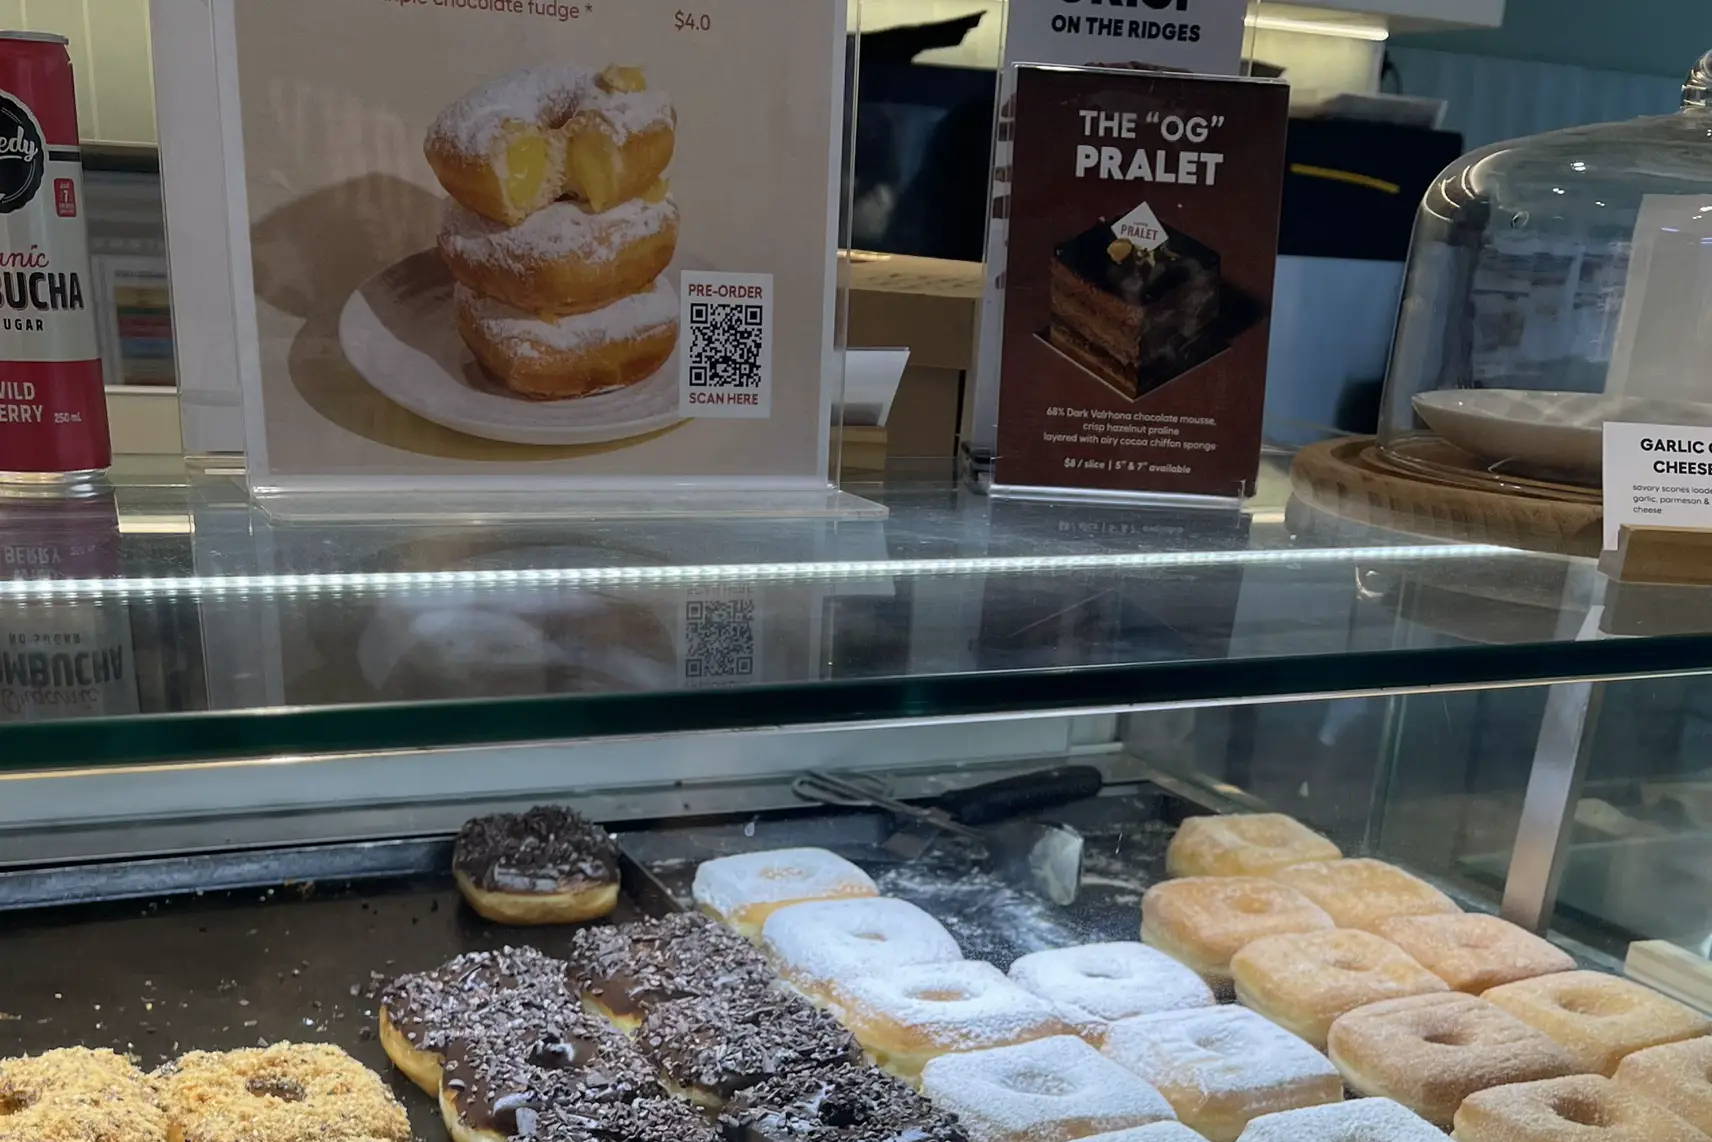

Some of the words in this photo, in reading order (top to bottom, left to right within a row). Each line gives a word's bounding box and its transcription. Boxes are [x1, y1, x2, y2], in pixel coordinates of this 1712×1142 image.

[528, 0, 580, 21] fudge
[674, 10, 711, 31] $4.0
[1051, 14, 1081, 33] ON
[1086, 17, 1124, 37] THE
[1128, 20, 1201, 42] RIDGES
[1079, 110, 1137, 138] THE
[1075, 145, 1224, 186] PRALET
[1120, 223, 1159, 241] PRALET
[0, 271, 84, 311] UCHA
[688, 283, 763, 299] PRE-ORDER
[4, 318, 44, 331] UGAR
[689, 392, 725, 405] SCAN
[727, 393, 759, 405] HERE
[1066, 407, 1088, 418] Dark
[1090, 409, 1132, 421] Valrhona
[1133, 412, 1178, 424] chocolate
[1083, 422, 1105, 432] crisp
[1107, 423, 1146, 434] hazelnut
[1148, 426, 1179, 436] praline
[1043, 432, 1078, 443] layered
[1079, 434, 1099, 444] with
[1101, 436, 1118, 446] airy
[1120, 438, 1148, 447] cocoa
[1150, 438, 1181, 449] chiffon
[1183, 442, 1217, 452] sponge
[1640, 438, 1705, 454] GARLIC
[1084, 459, 1105, 469] slice
[1149, 463, 1192, 474] available
[1660, 497, 1702, 505] parmesan
[1633, 506, 1662, 514] cheese
